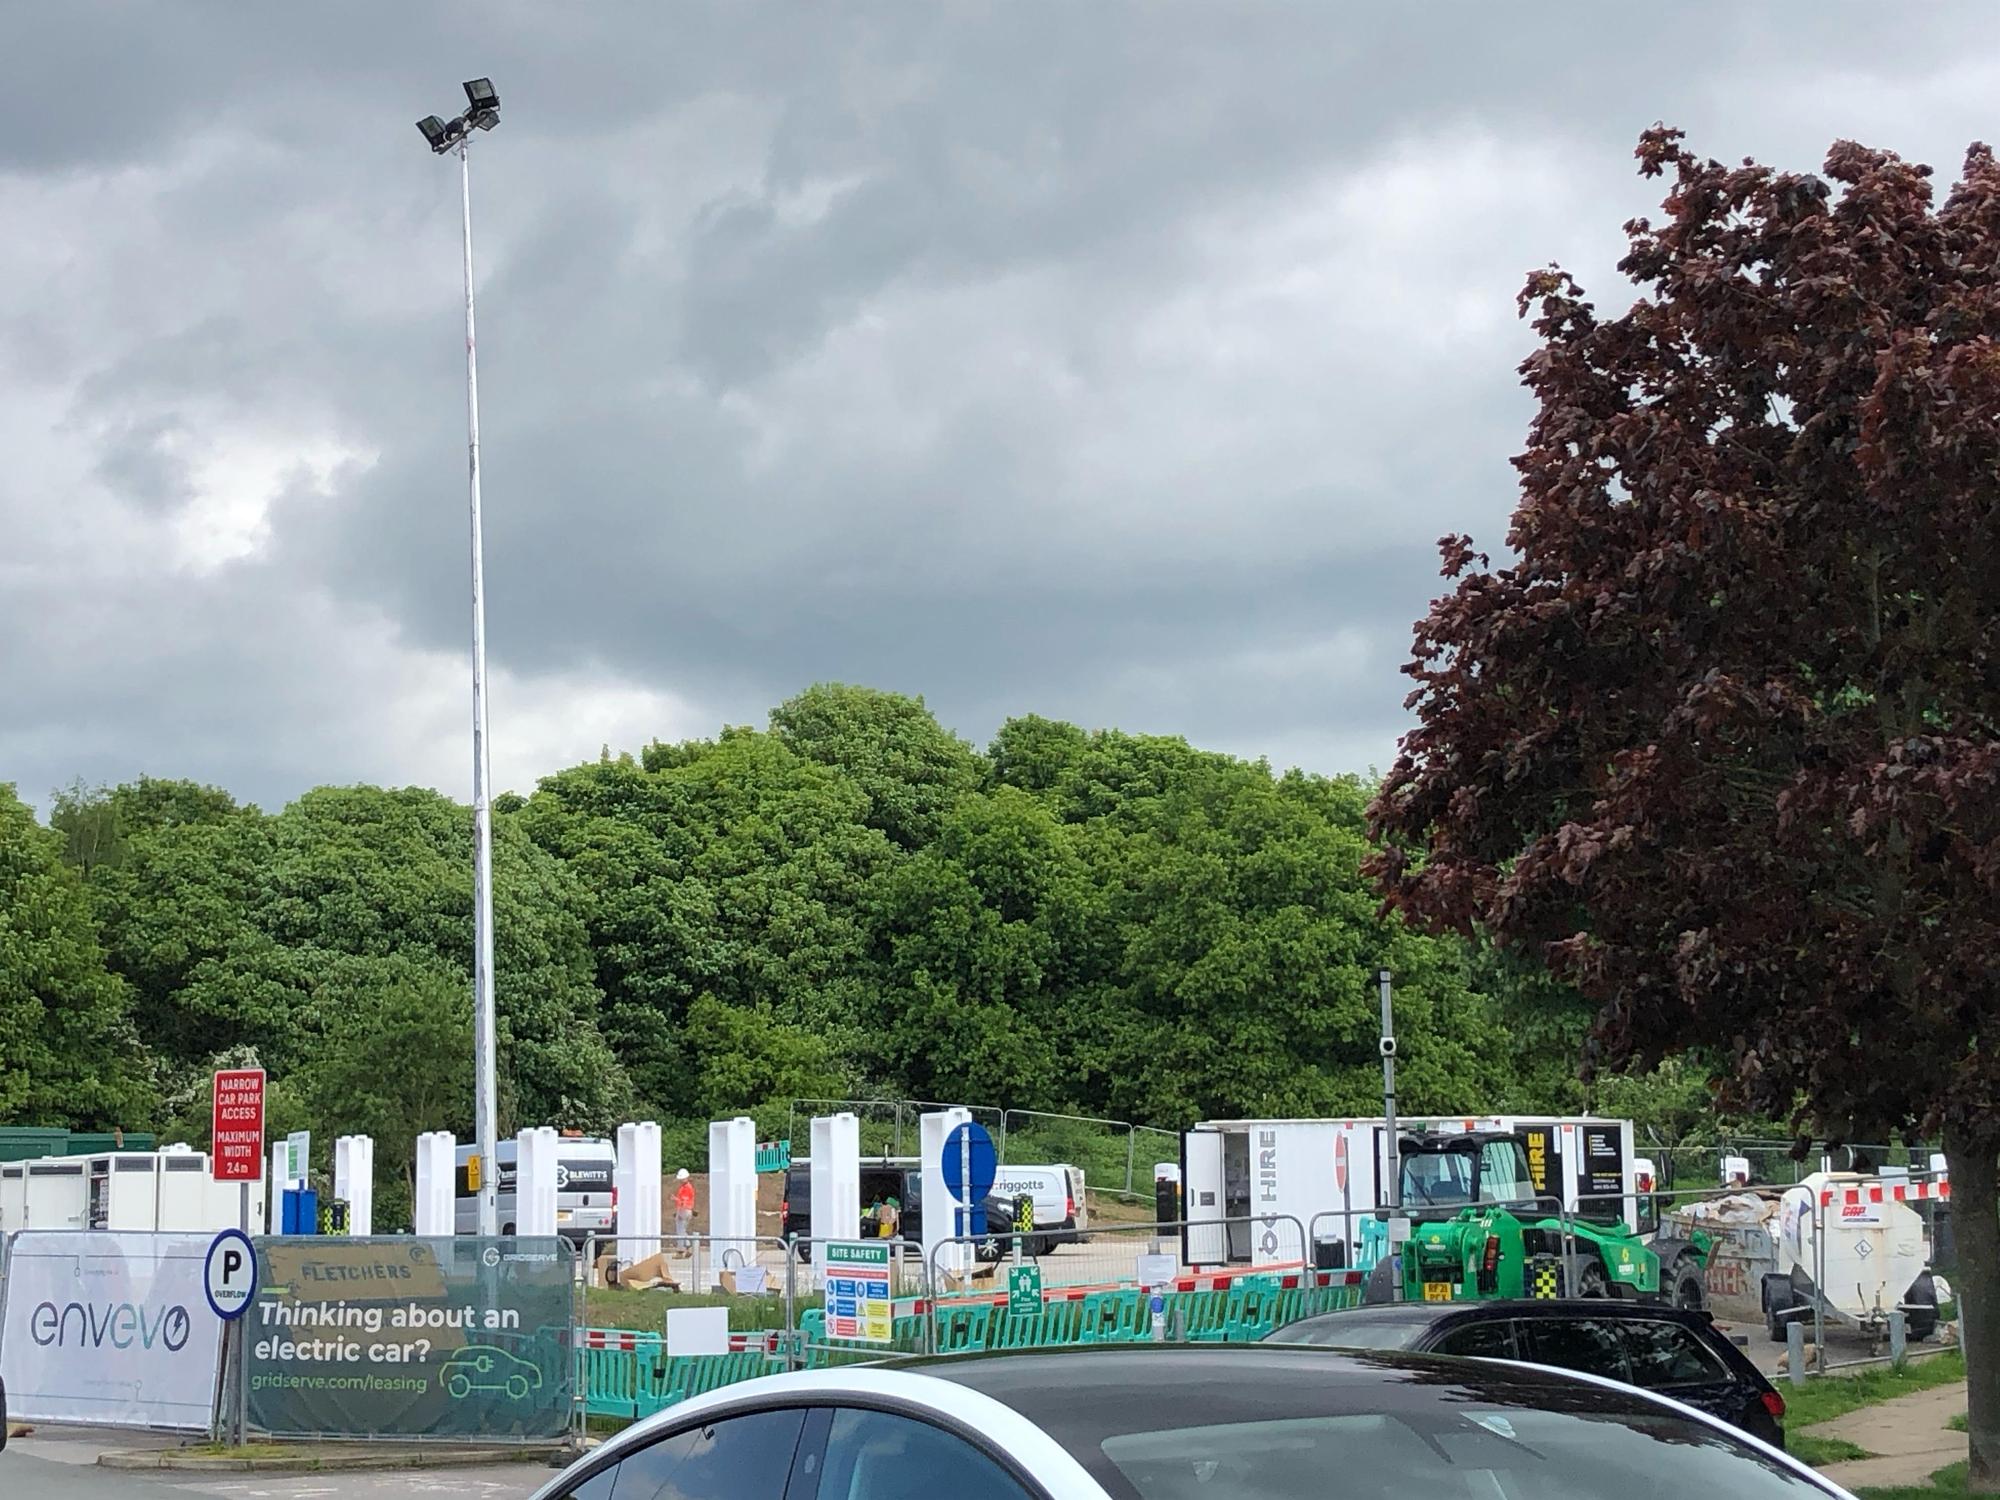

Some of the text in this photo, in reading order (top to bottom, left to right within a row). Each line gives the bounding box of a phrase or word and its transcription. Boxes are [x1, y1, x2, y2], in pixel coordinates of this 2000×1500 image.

[221, 1079, 260, 1091] NARROW
[218, 1092, 261, 1106] CAR PARK
[221, 1107, 257, 1120] ACCESS
[217, 1130, 260, 1143] MAXIMUM
[224, 1145, 252, 1157] WIDTH
[1259, 1130, 1278, 1201] HIRE
[1527, 1132, 1546, 1191] HIRE
[569, 1170, 608, 1180] BLEWITT'S
[502, 1252, 559, 1263] GRIDSERVE
[831, 1246, 882, 1260] SITE SAFETY
[222, 1250, 242, 1285] P
[301, 1261, 412, 1283] FLETCHERS
[214, 1289, 247, 1299] OVERFLOW
[258, 1300, 520, 1333] Thinking about an
[30, 1301, 191, 1352] envevo
[254, 1335, 432, 1363] electric car?
[251, 1371, 428, 1394] gridserve.com/leasing
